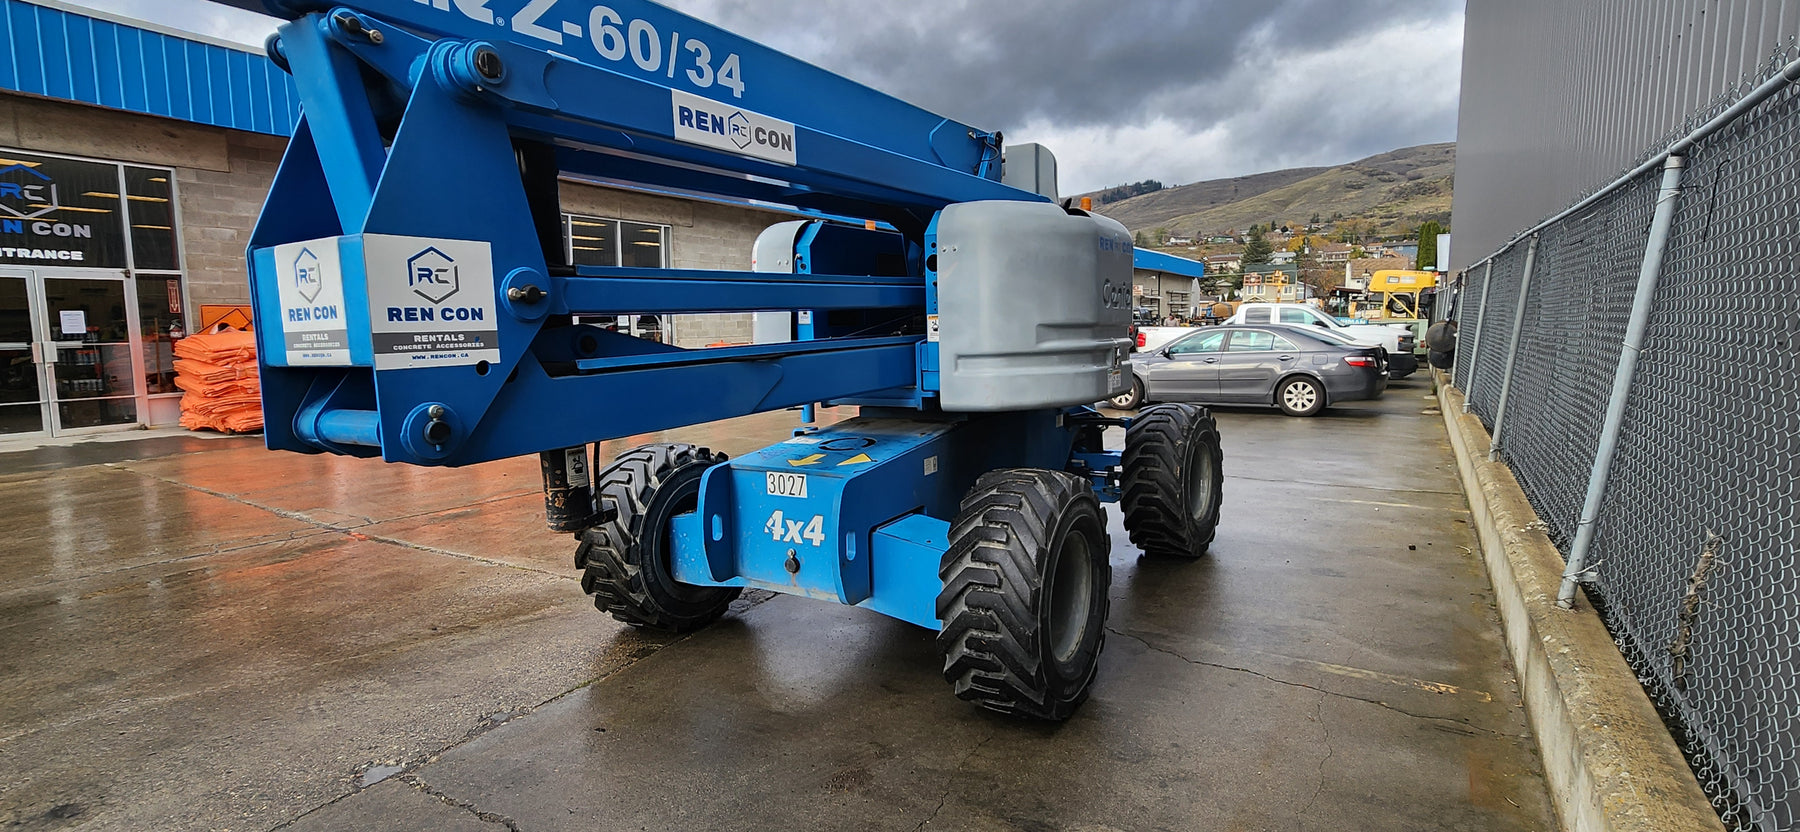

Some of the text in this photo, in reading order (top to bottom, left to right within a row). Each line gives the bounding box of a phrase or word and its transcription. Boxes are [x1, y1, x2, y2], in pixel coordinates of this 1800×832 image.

[511, 0, 745, 98] Z-60/34
[679, 105, 725, 136] REN
[754, 127, 792, 151] CON
[31, 221, 92, 238] CON
[288, 304, 338, 322] REN CON
[387, 307, 484, 322] REN CON
[413, 333, 465, 343] RENTALS
[768, 473, 805, 496] 3027
[764, 510, 826, 547] 4x4
